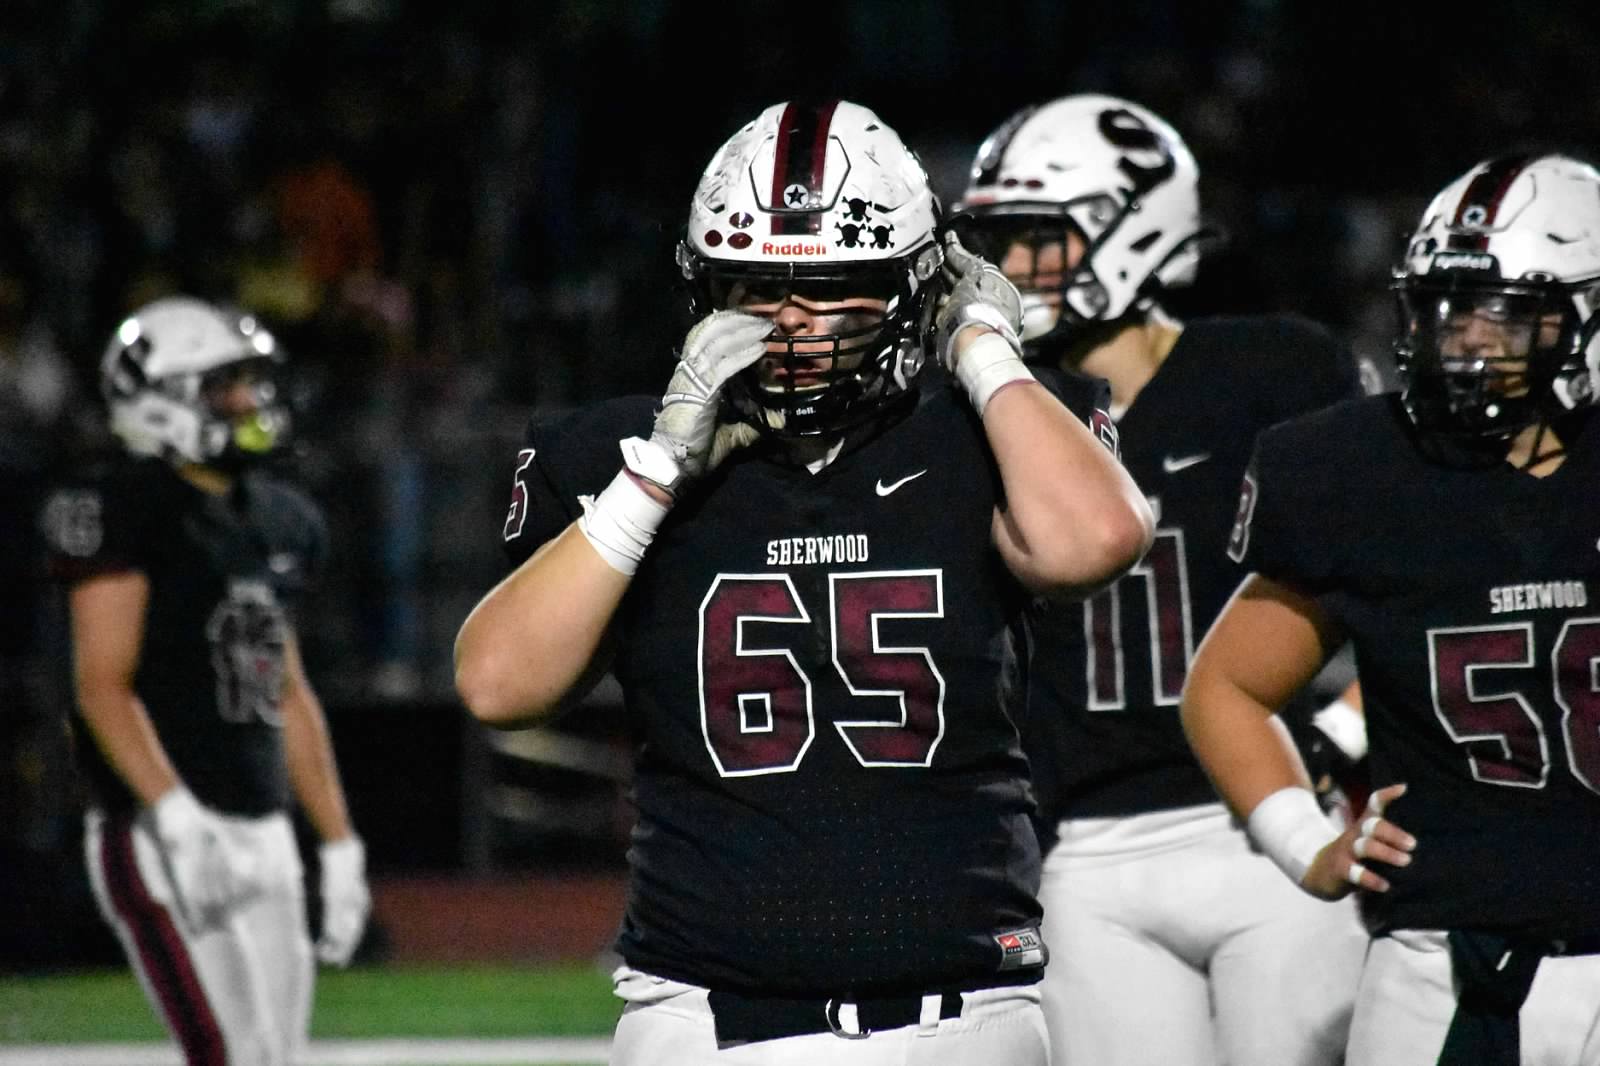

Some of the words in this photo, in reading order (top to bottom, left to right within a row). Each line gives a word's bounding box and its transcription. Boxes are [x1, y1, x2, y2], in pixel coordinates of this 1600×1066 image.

[762, 241, 827, 256] Riddell
[766, 534, 869, 565] SHERWOOD
[1489, 581, 1588, 614] SHERWOOD
[697, 568, 945, 778] 65
